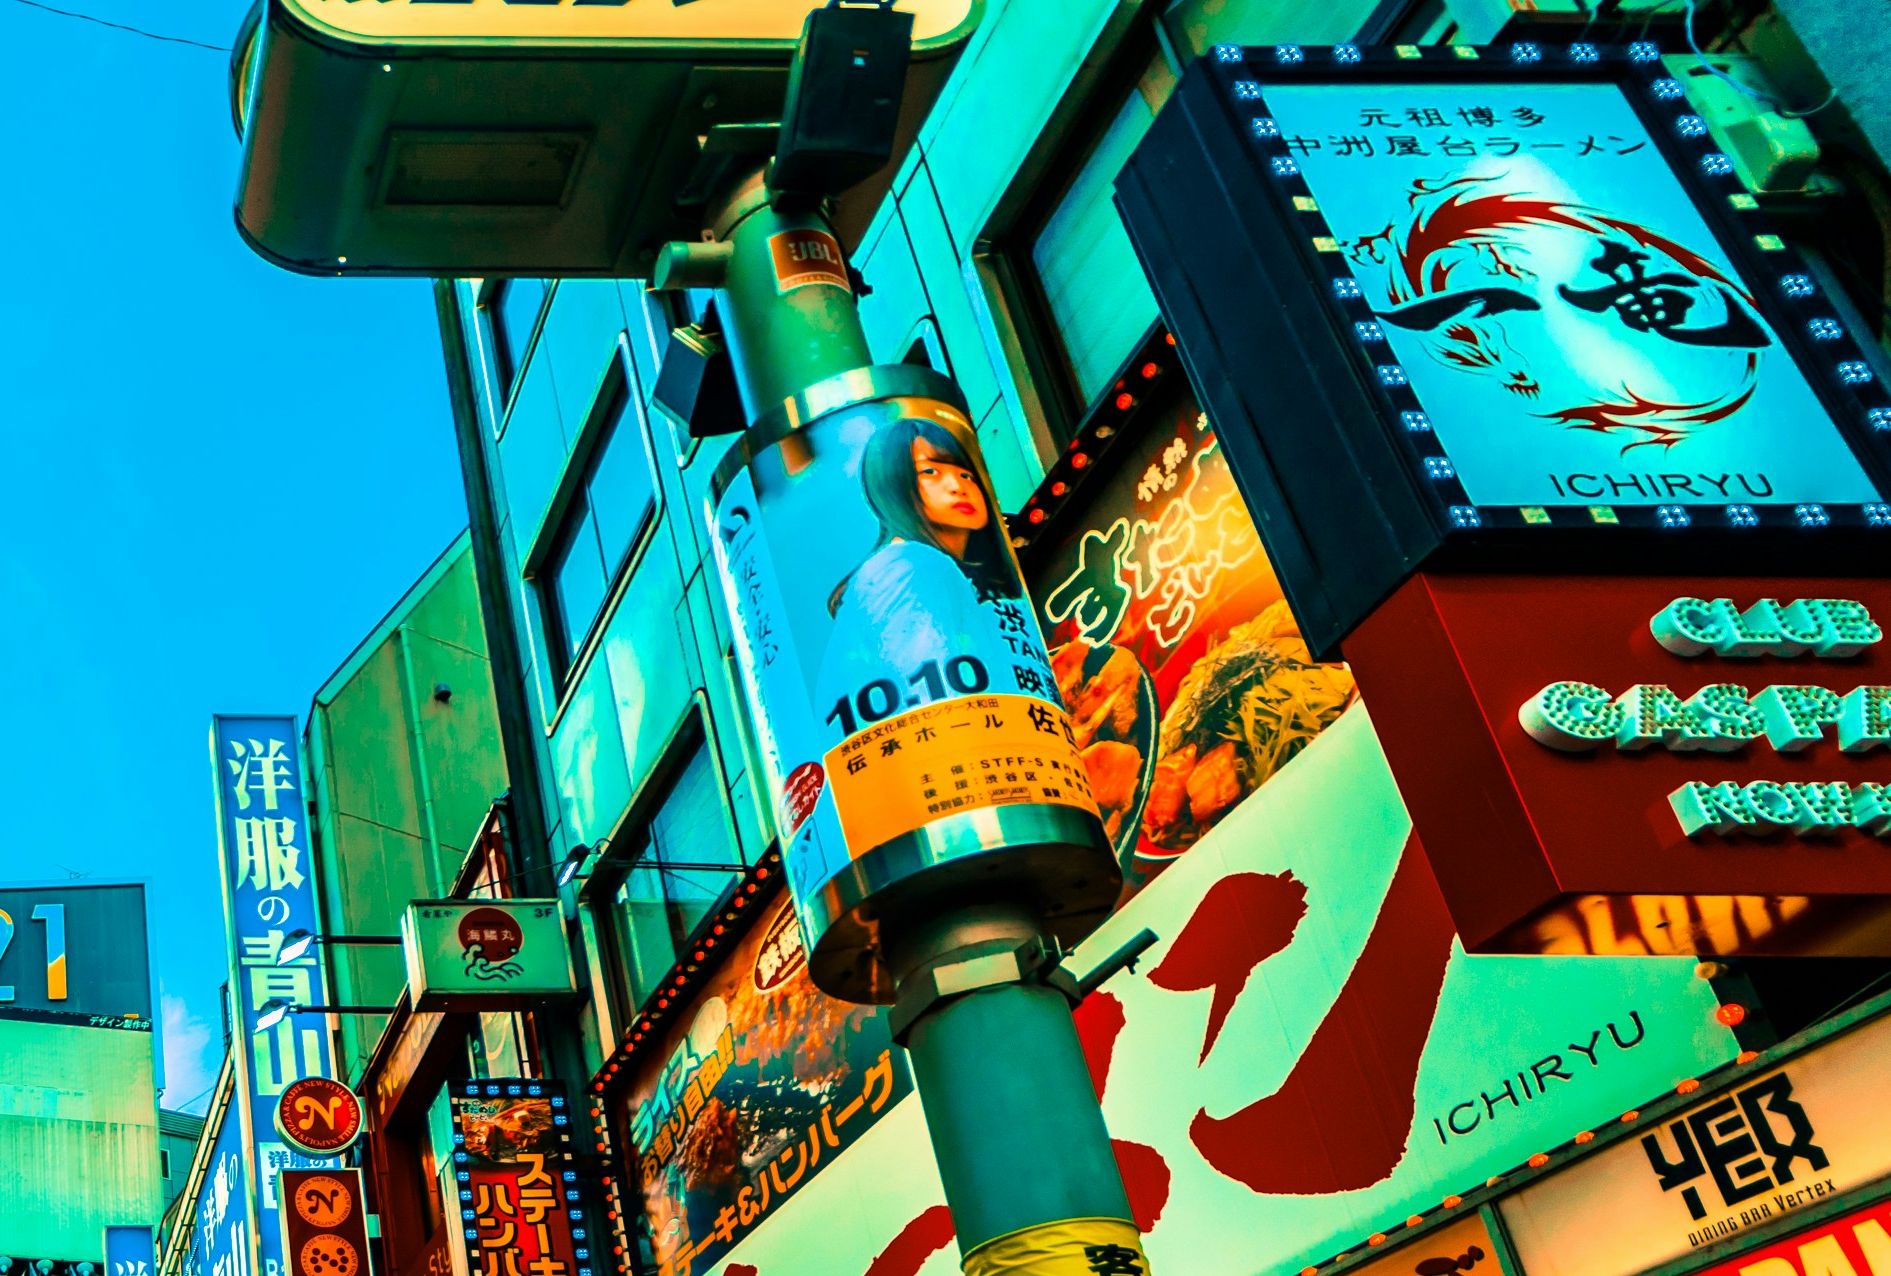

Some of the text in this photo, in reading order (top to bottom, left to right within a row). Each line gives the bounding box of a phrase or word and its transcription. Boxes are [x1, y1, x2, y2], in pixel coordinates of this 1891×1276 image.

[1359, 106, 1548, 129] 元祖博多
[1284, 135, 1647, 158] 中洲屋台ラーメン
[789, 239, 839, 267] JBL
[1549, 473, 1774, 498] ICHIRYU
[1649, 596, 1884, 658] CLUB
[840, 699, 999, 757] 渋谷区文化総合センター大和田
[846, 714, 1004, 776] 伝承ホール
[979, 757, 1044, 770] STFF-S
[227, 737, 321, 1096] 洋服の青山
[533, 907, 554, 919] 3F
[304, 1080, 324, 1088] NEW
[325, 1081, 351, 1101] STYLE
[1432, 1010, 1646, 1146] ICHIRYU
[632, 1035, 698, 1154] ライス
[295, 1095, 343, 1131] N
[306, 1188, 340, 1215] N
[1687, 1178, 1837, 1248] DINING BAR Vertex
